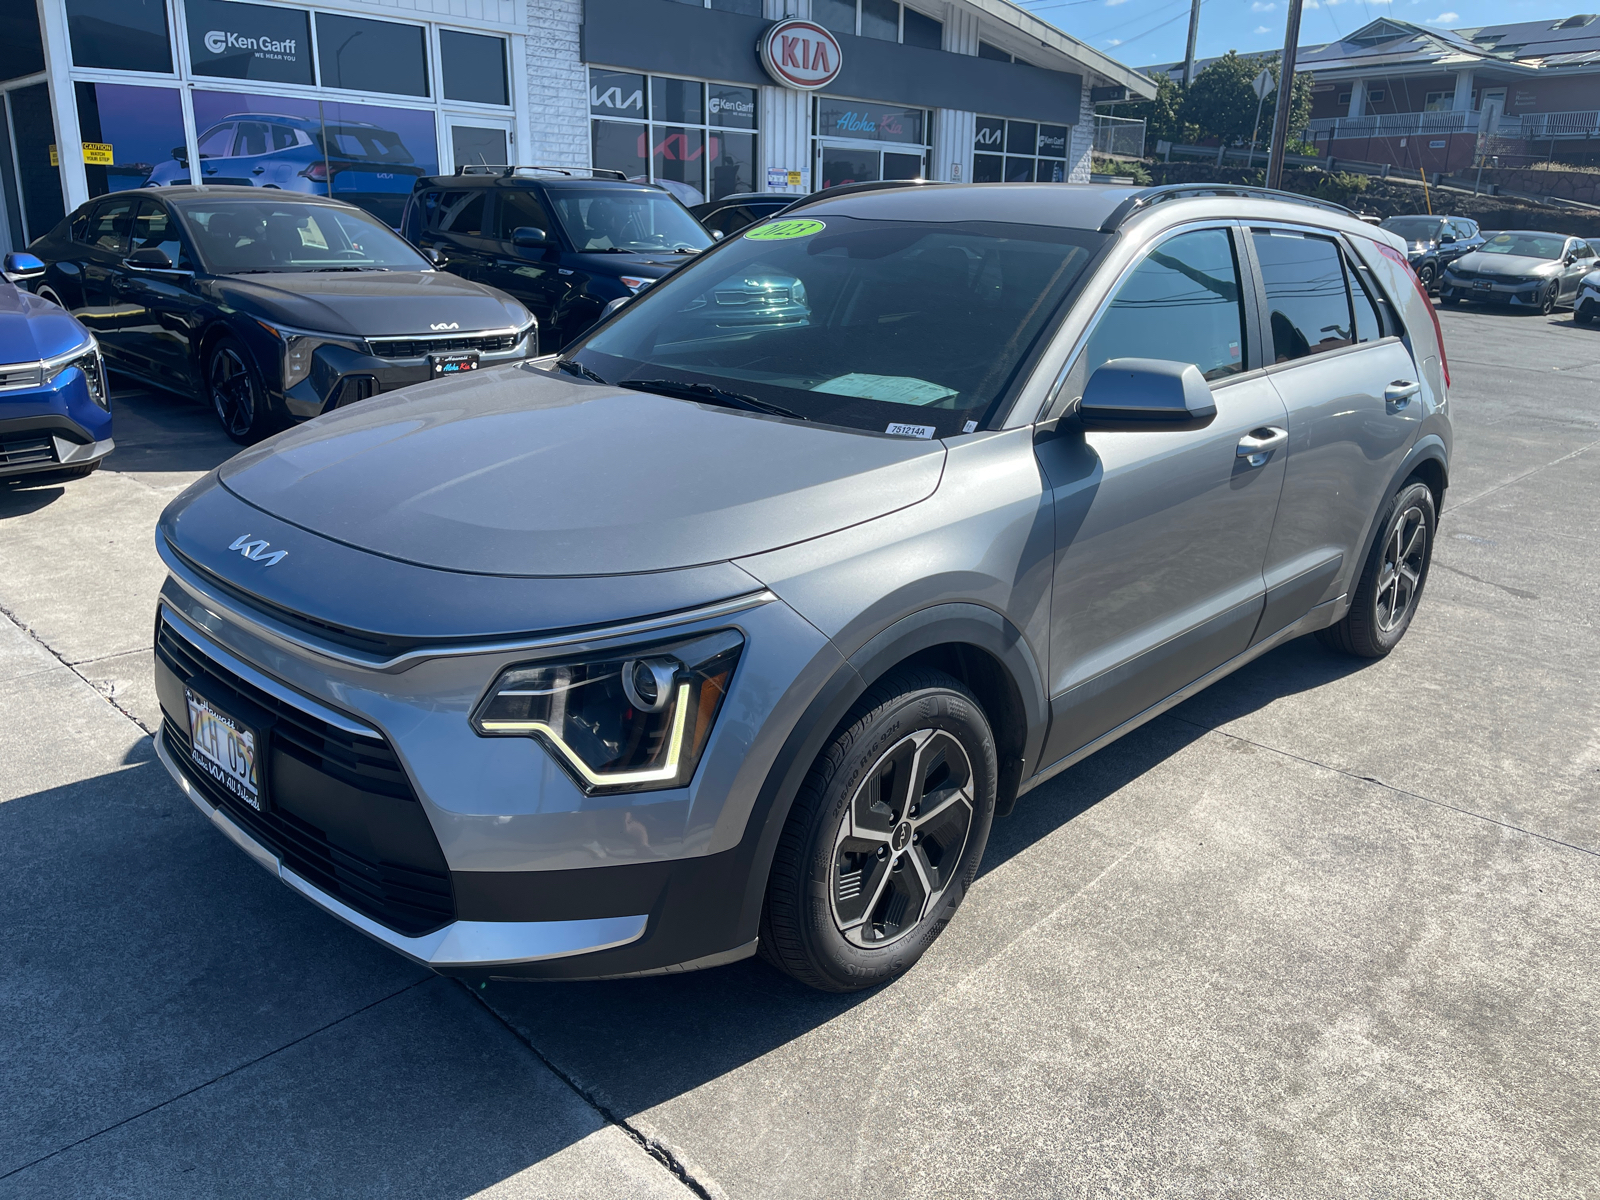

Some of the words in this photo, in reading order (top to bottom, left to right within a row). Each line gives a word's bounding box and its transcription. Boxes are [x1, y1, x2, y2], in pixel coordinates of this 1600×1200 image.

[227, 31, 258, 50] Ken
[259, 36, 296, 54] Garff
[781, 35, 830, 73] KIA
[254, 51, 265, 59] WE
[591, 84, 643, 111] KIA
[720, 99, 735, 110] Ken
[736, 101, 754, 112] Garff
[836, 111, 876, 132] Aloha
[878, 114, 903, 134] Kia
[83, 143, 111, 151] CAUTION
[750, 223, 816, 236] 2023
[430, 322, 459, 331] KIA
[443, 363, 459, 372] Aloha
[459, 362, 470, 370] Kia
[891, 425, 925, 436] 751214A
[228, 533, 288, 567] KIA
[200, 700, 236, 730] Hawaii
[188, 705, 220, 762] ZLH
[227, 731, 258, 788] 052
[191, 750, 209, 772] Aloha
[226, 776, 237, 793] All
[237, 784, 261, 812] Islands
[832, 769, 859, 819] 205/60
[860, 742, 879, 768] R16
[880, 720, 900, 743] 92H
[844, 957, 903, 979] SOLUS
